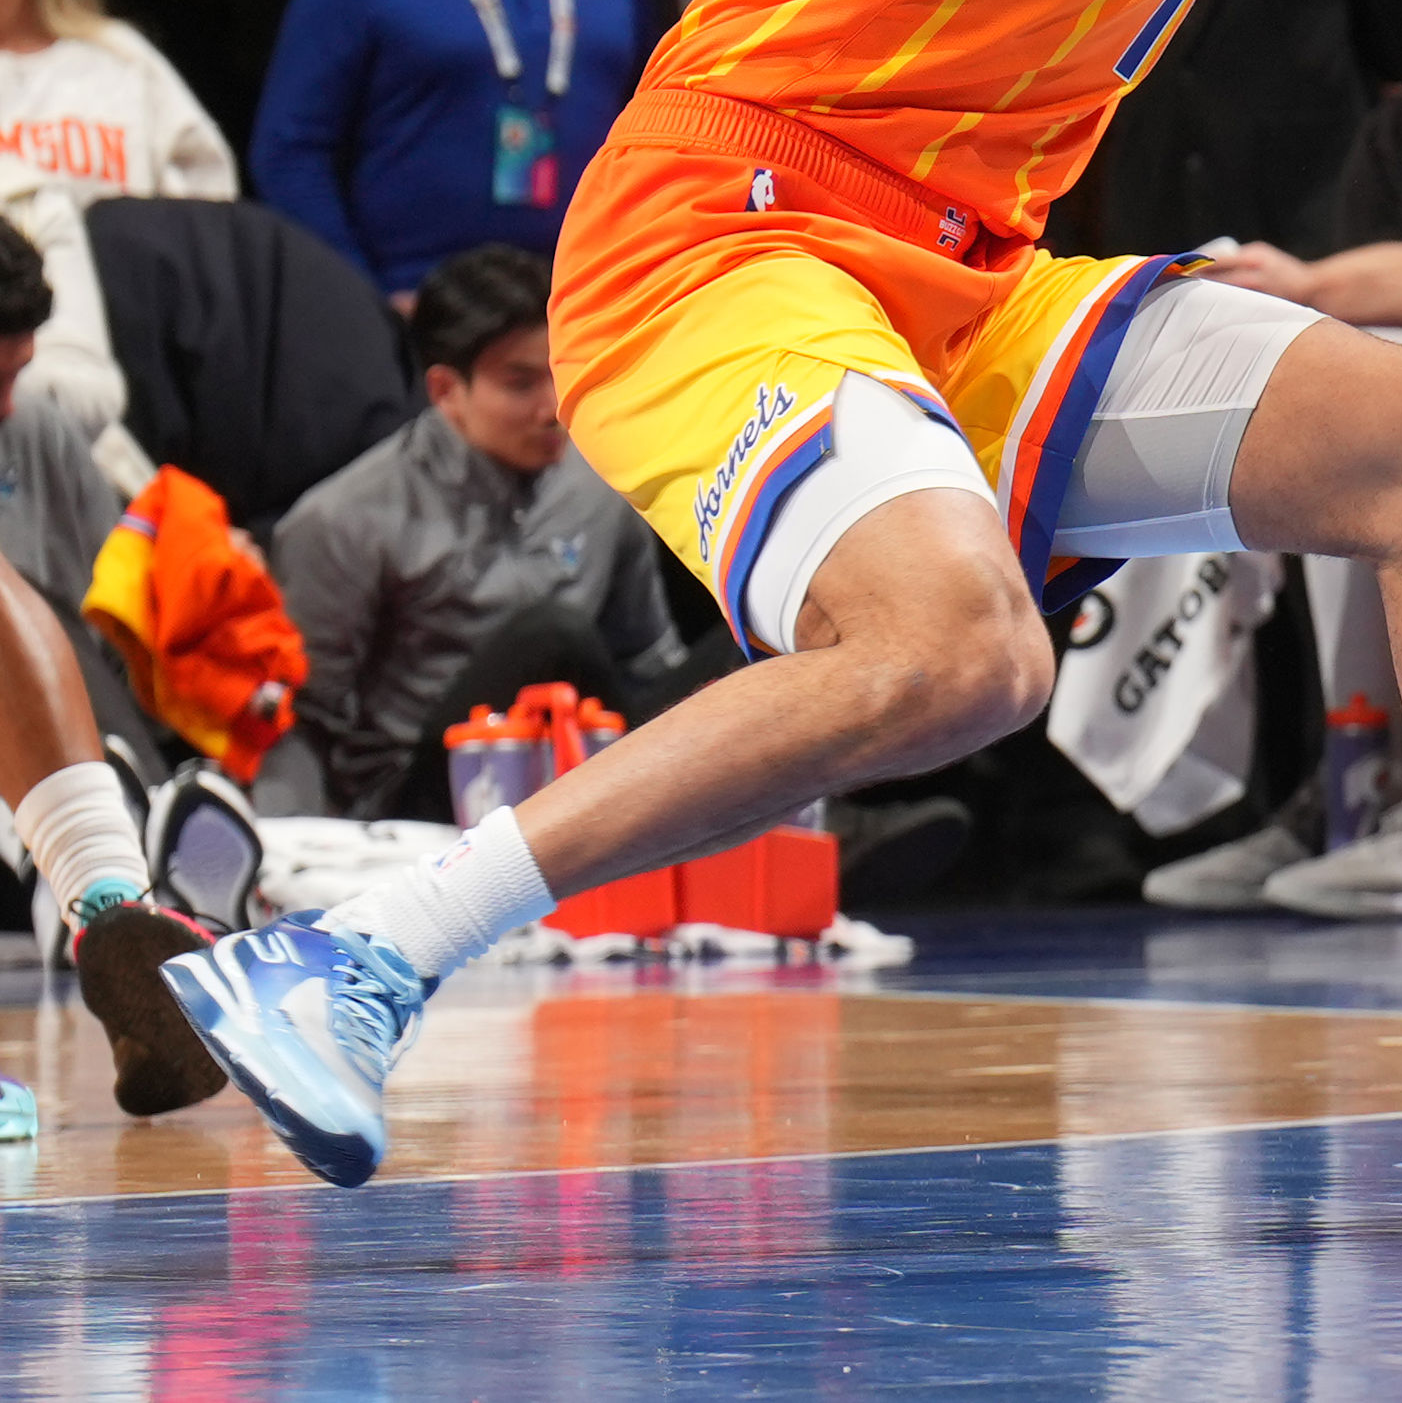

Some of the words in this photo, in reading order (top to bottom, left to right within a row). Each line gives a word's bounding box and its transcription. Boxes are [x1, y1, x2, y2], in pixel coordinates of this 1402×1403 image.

[0, 117, 126, 188] MSON
[693, 383, 796, 563] Hornets
[1114, 558, 1229, 715] GATOR
